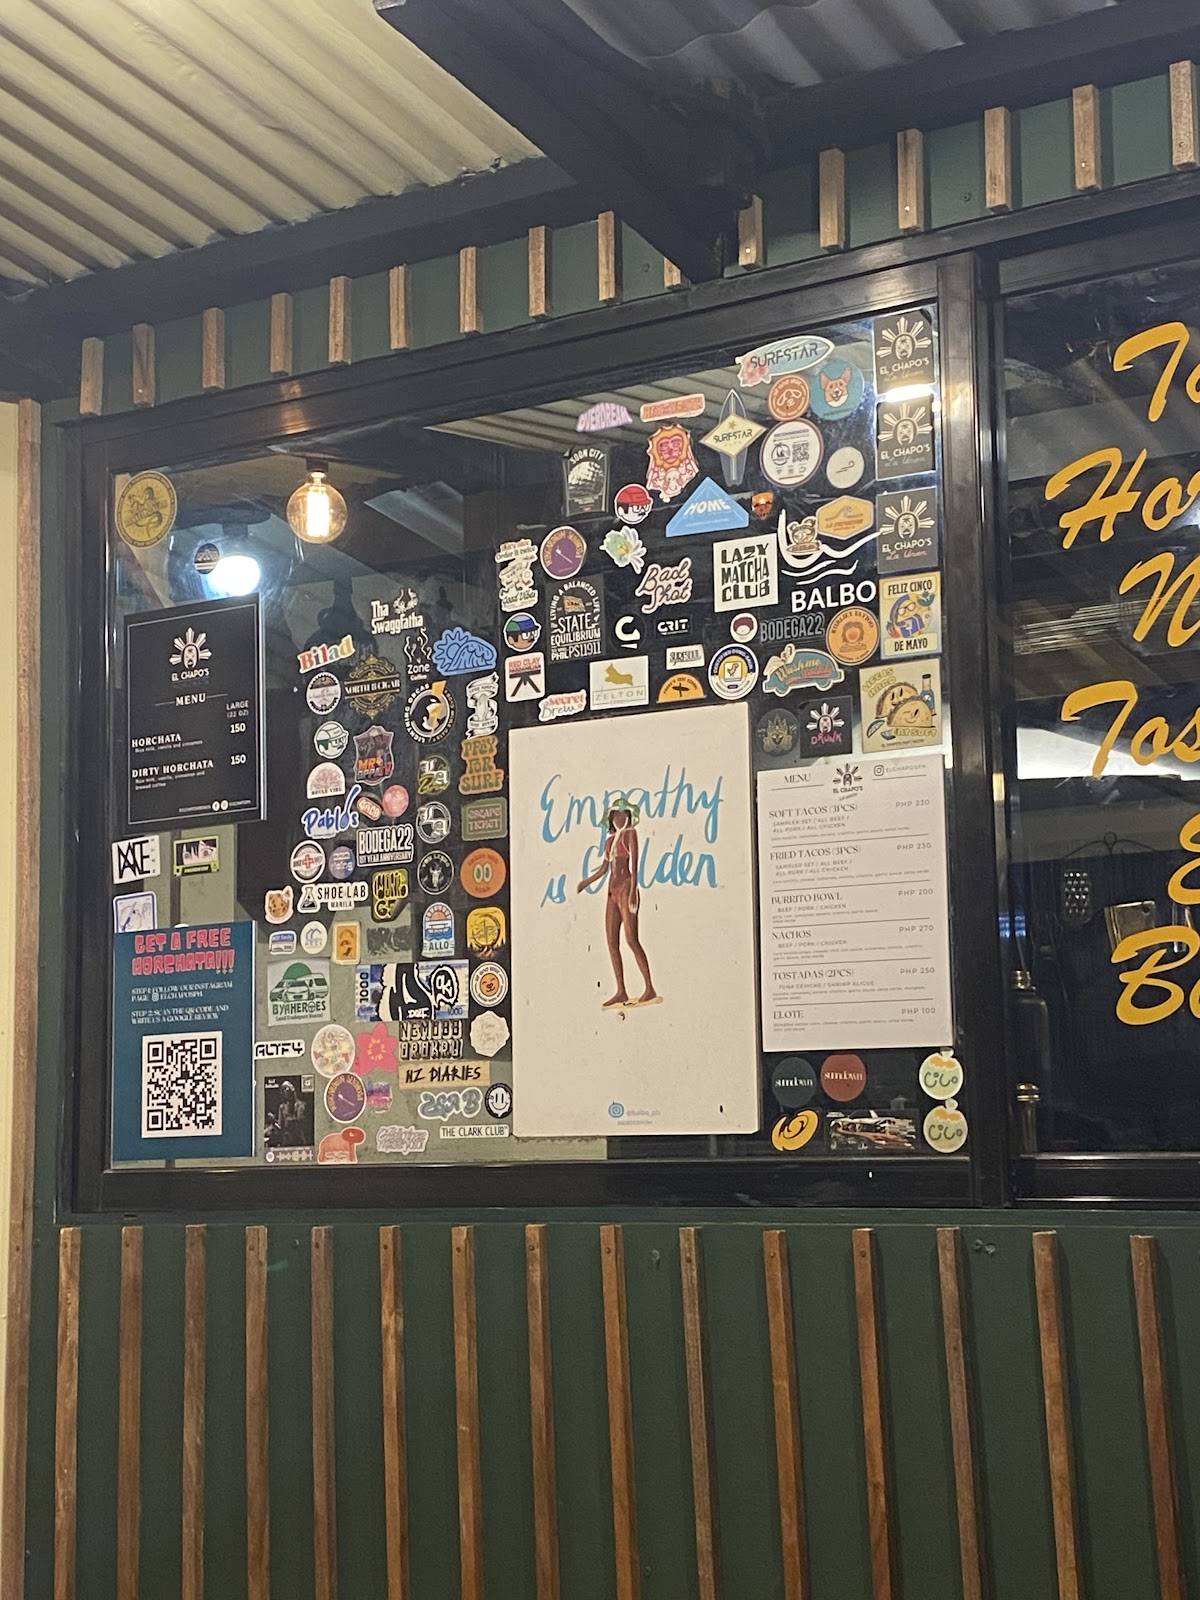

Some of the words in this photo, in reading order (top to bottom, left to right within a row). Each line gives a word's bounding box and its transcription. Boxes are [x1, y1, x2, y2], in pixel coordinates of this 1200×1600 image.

[749, 342, 818, 368] SURFSTAR
[880, 366, 889, 375] EL
[892, 357, 930, 372] CHAPO'S
[713, 428, 753, 443] SURFSTAR
[880, 451, 890, 461] EL
[893, 443, 931, 457] CHAPO'S
[684, 498, 732, 516] HOME
[720, 542, 769, 565] LAZY
[882, 543, 892, 553] EL
[894, 537, 933, 552] CHAPO'S
[639, 560, 690, 593] Bad
[720, 556, 770, 586] MATCHA
[563, 580, 596, 598] BALANCED
[721, 580, 770, 603] CLUB
[791, 580, 877, 613] BALBO
[888, 582, 908, 596] FELIZ
[909, 579, 933, 593] CINCO
[371, 600, 389, 618] Tha
[371, 612, 424, 635] Swaggfatha
[558, 612, 593, 634] STATE
[761, 614, 824, 642] BODEGA22
[550, 628, 601, 648] EQUILIBRIUM
[894, 641, 904, 652] DE
[905, 637, 928, 651] MAYO
[298, 635, 354, 673] Bilad
[175, 693, 206, 706] MENU
[226, 700, 249, 711] LARGE
[230, 722, 246, 734] 150
[131, 733, 182, 748] HORCHATA
[811, 732, 842, 746] DRUNK
[230, 754, 247, 765] 150
[131, 766, 160, 778] DIRTY
[162, 760, 214, 774] HORCHATA
[460, 770, 503, 792] SURF
[784, 773, 811, 784] MENU
[540, 764, 724, 843] Empathy
[795, 805, 828, 817] TACOS
[359, 827, 412, 854] BODEGA22
[770, 851, 797, 861] FRIED
[799, 847, 832, 858] TACOS
[582, 834, 717, 895] Glden
[317, 886, 343, 899] SHOE
[346, 885, 367, 899] LAB
[771, 894, 812, 905] BURRITO
[813, 891, 842, 903] BOWL
[135, 933, 167, 954] GET
[171, 931, 181, 951] A
[186, 927, 231, 949] FREE
[772, 929, 812, 940] NACHOS
[428, 941, 450, 951] ALLO
[773, 969, 825, 980] TOSTADAS
[359, 972, 369, 1003] 1000
[272, 1000, 326, 1015] BYAHEROES
[773, 1009, 805, 1020] ELOTE
[429, 1065, 481, 1082] DIARIES
[441, 1127, 456, 1137] THE
[458, 1126, 482, 1137] CLARK
